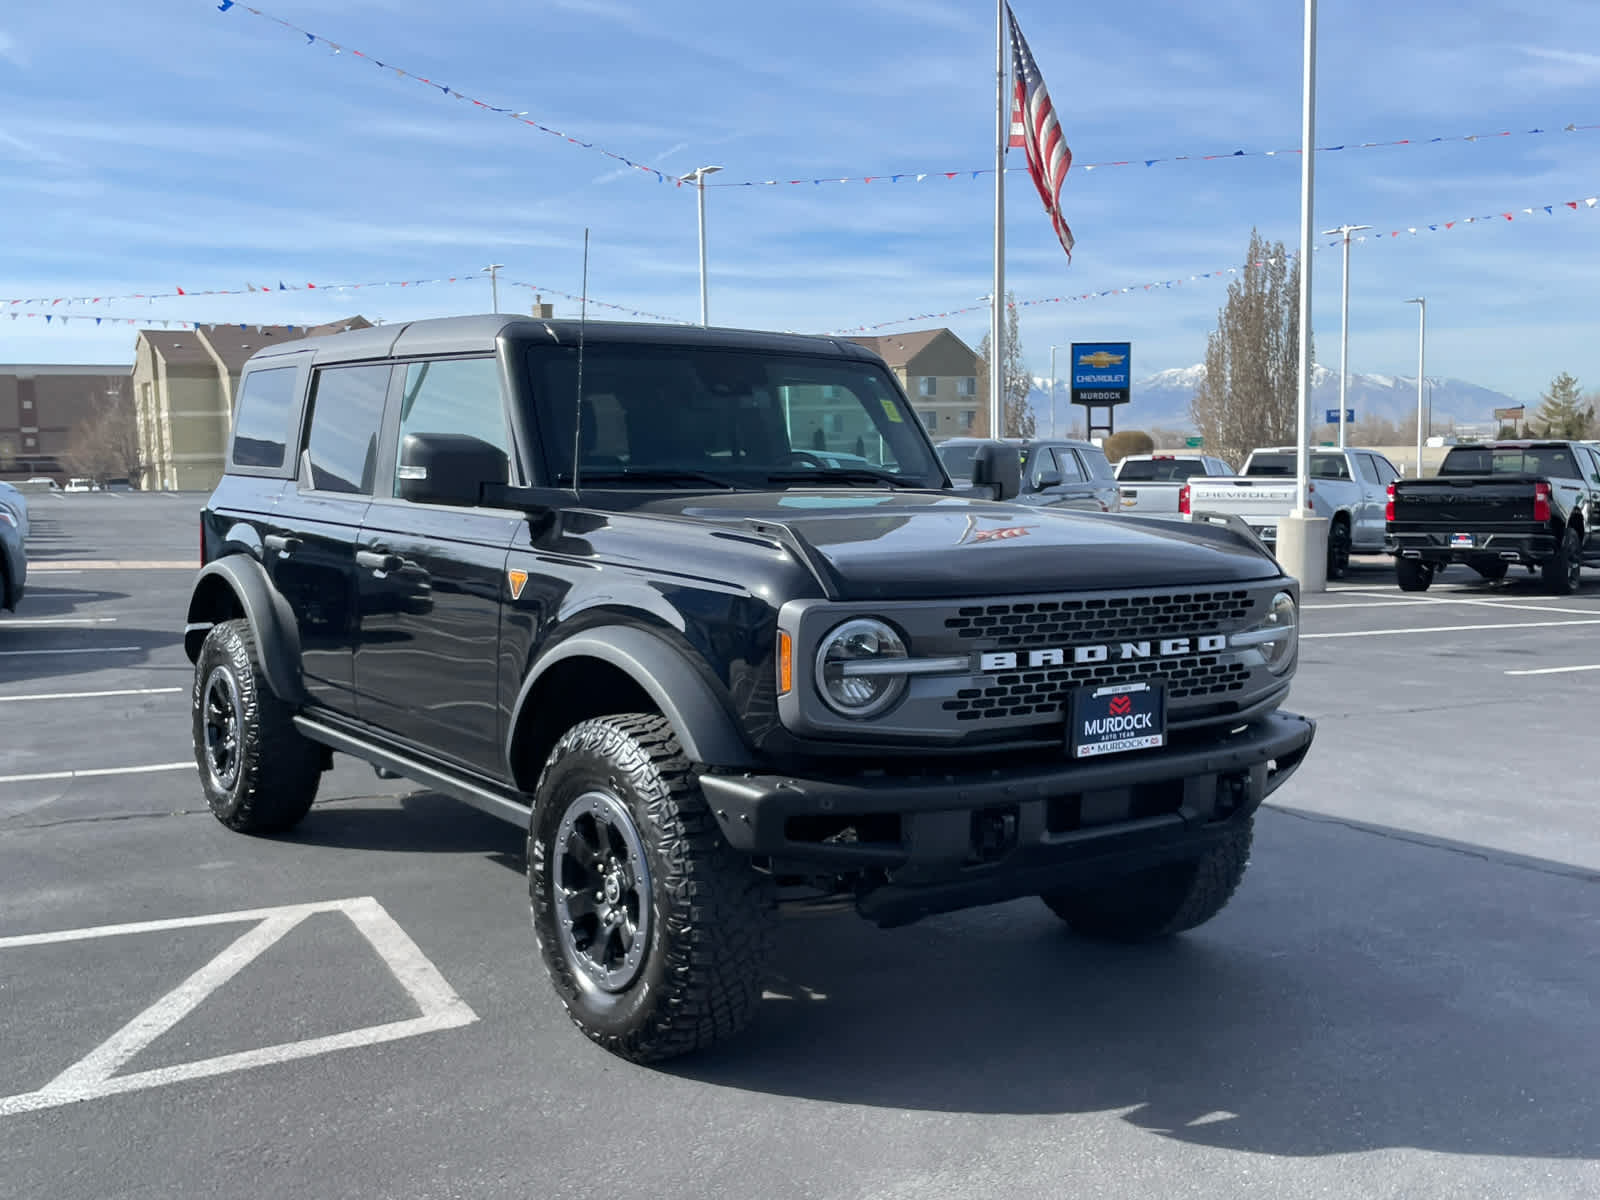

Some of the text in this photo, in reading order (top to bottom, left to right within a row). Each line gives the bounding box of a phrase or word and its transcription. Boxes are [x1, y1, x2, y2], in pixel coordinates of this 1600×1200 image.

[980, 634, 1226, 671] BRONCO
[1084, 712, 1152, 736] MURDOCK
[1119, 731, 1135, 739] TEAM
[1097, 739, 1143, 752] MURDOCK
